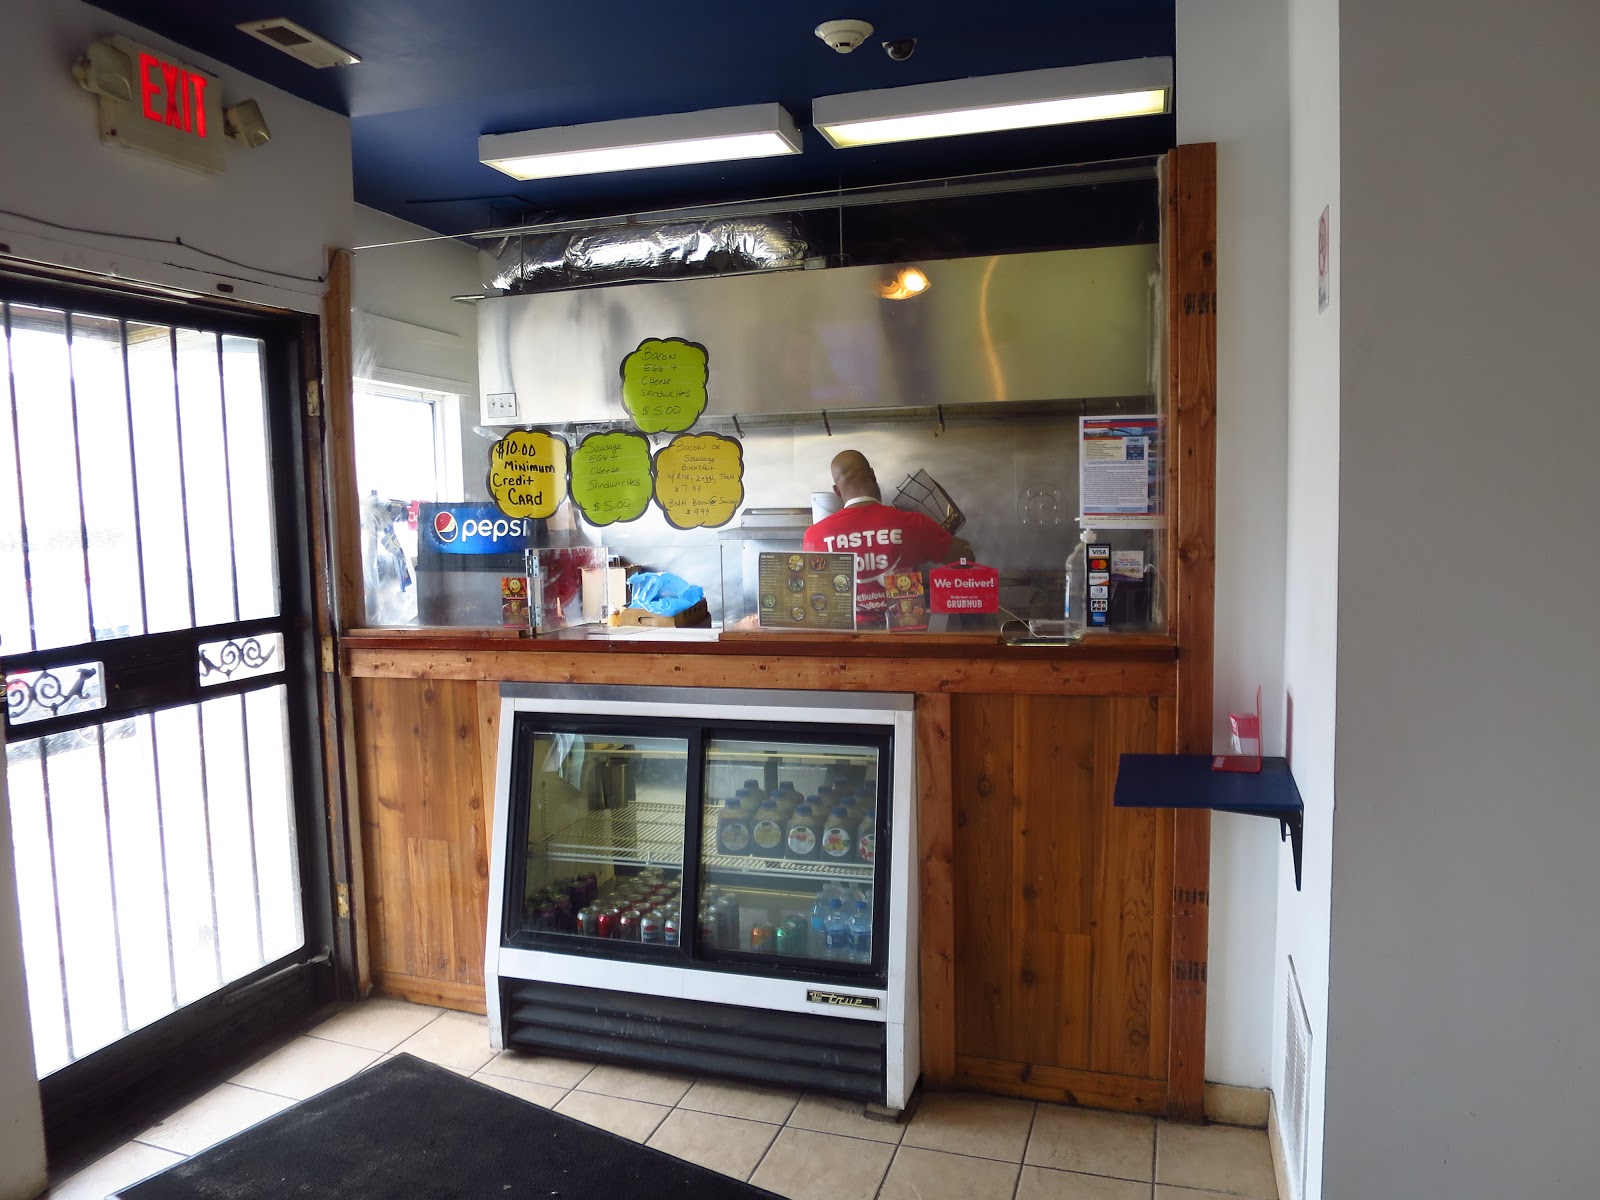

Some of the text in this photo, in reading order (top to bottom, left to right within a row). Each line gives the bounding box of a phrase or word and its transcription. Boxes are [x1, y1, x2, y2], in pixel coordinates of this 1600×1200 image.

[138, 52, 207, 138] EXIT
[495, 440, 536, 460] $10.00
[584, 442, 622, 454] Sausage
[683, 454, 716, 465] Sausage
[492, 472, 535, 487] Credit
[461, 518, 528, 542] pepsi
[823, 528, 904, 553] TASTEE
[856, 552, 889, 572] olls
[933, 577, 995, 588] We Deliver!
[946, 599, 983, 609] GRUBHUB
